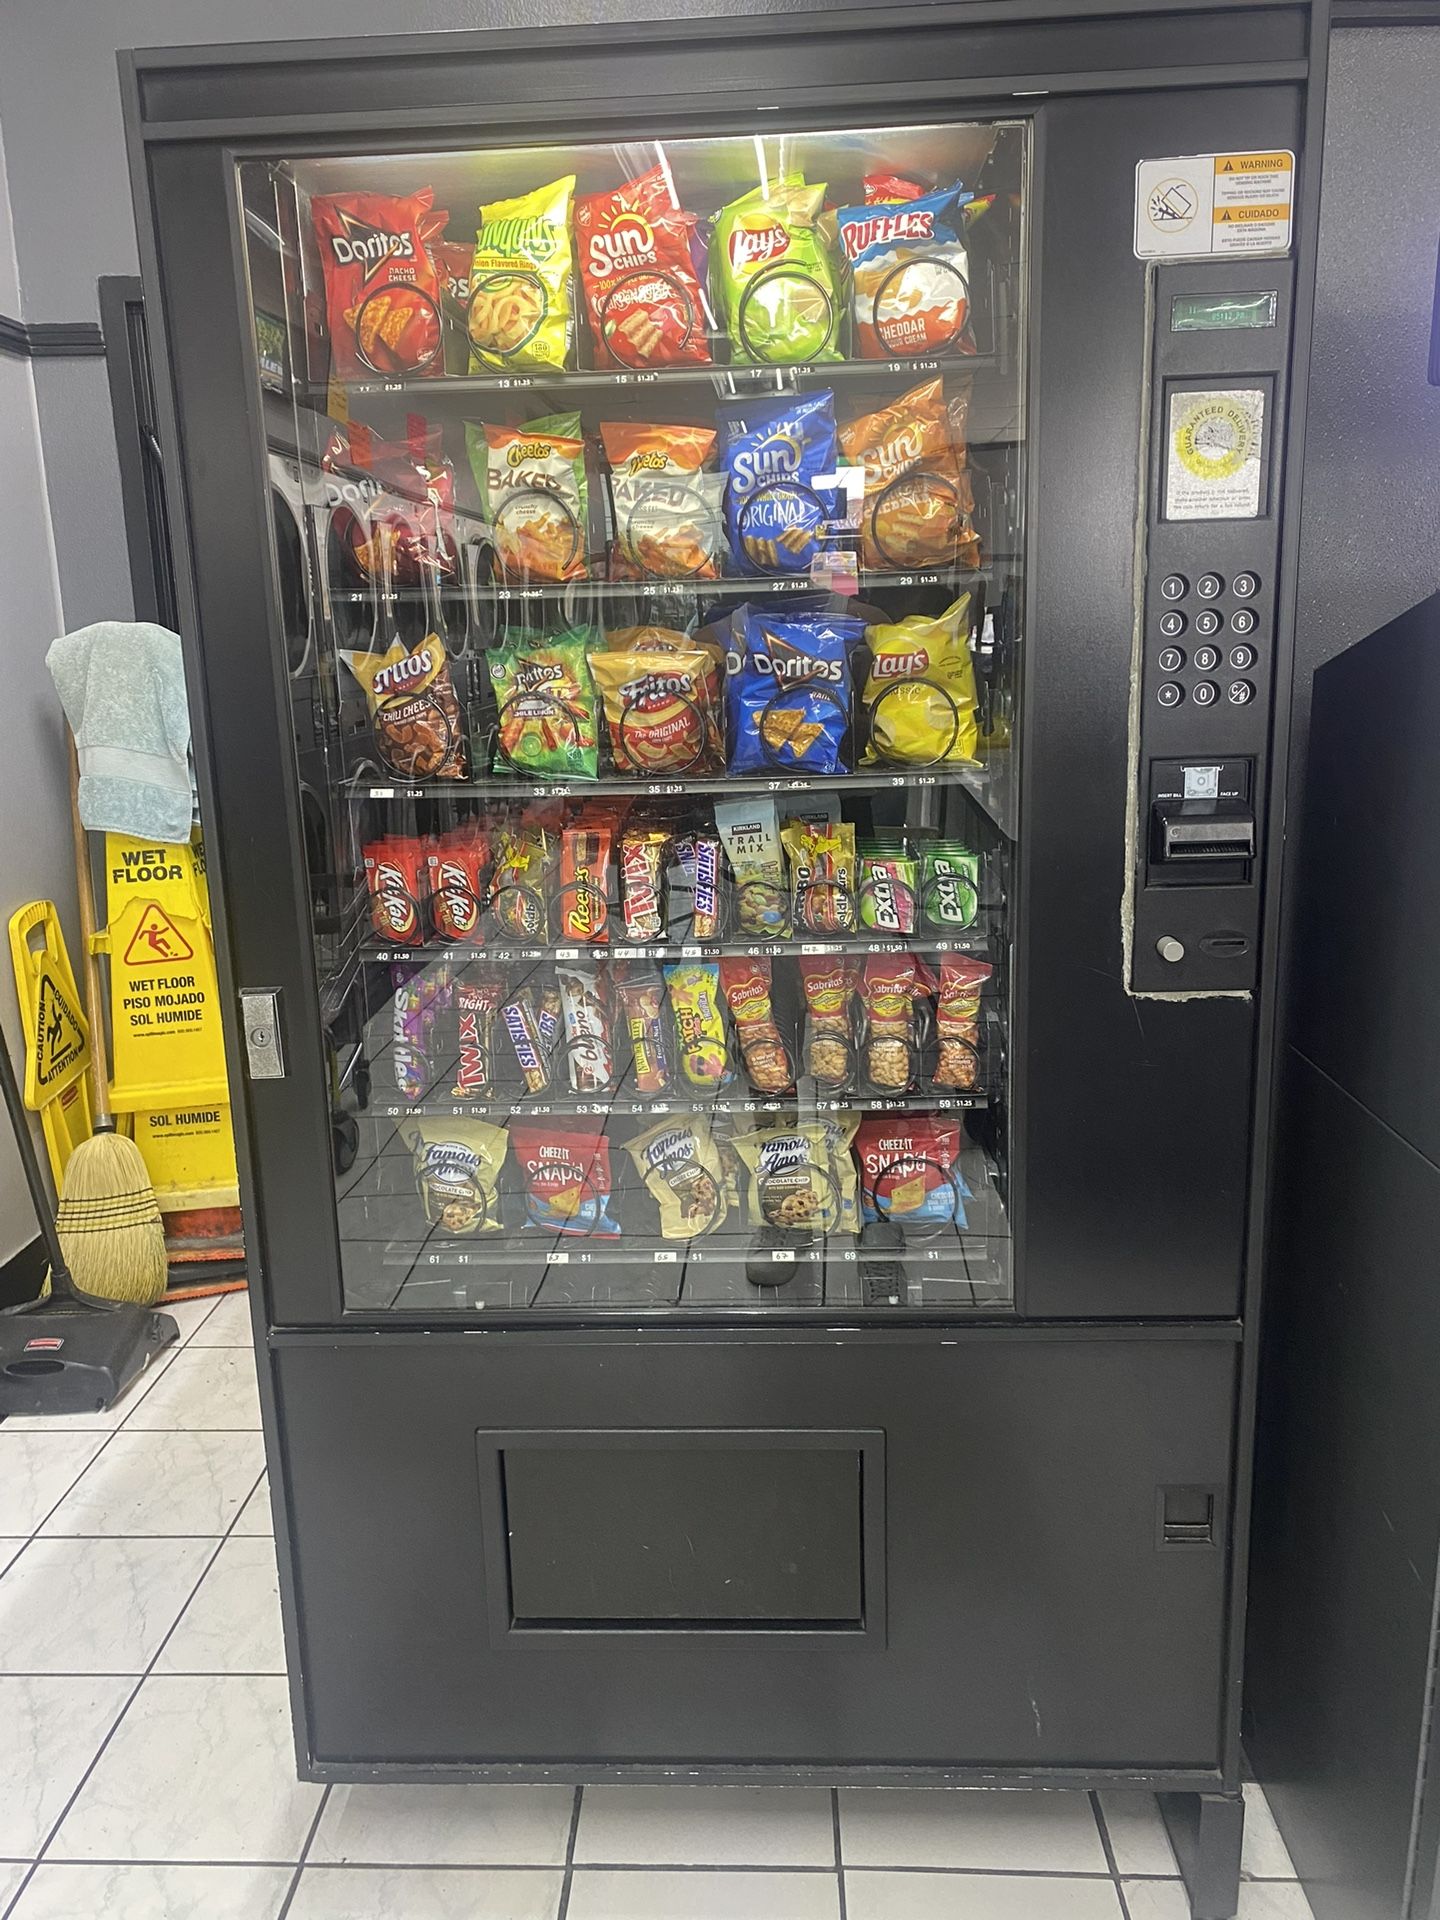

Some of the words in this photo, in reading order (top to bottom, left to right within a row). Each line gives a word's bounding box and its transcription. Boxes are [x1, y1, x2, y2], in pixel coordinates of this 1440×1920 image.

[1240, 159, 1283, 169] WARNING
[1238, 208, 1279, 219] CUIDADO
[842, 213, 934, 259] RUFFLES
[333, 232, 414, 263] Doritos
[733, 226, 788, 264] Lay's
[589, 229, 655, 278] Sun
[490, 258, 519, 268] Flavored
[613, 251, 657, 270] CHIPS
[389, 267, 415, 275] NACHO
[388, 274, 417, 282] CHEESE
[888, 363, 901, 372] 19
[919, 361, 938, 369] $1.25
[750, 369, 762, 378] 17
[498, 379, 510, 388] 13
[513, 378, 531, 387] $1.25
[615, 375, 627, 384] 15
[637, 374, 655, 383] $1.25
[1184, 406, 1225, 456] GUARANTEED
[1227, 409, 1247, 454] DELIVERY
[507, 442, 551, 468] Cheetos
[732, 450, 802, 494] Sun
[487, 468, 562, 491] BAKED
[756, 472, 800, 487] CHIPS
[900, 576, 913, 585] 29
[920, 575, 938, 583] $1.25
[643, 587, 656, 595] 25
[772, 582, 785, 591] 27
[791, 581, 808, 589] $1.25
[1169, 582, 1175, 594] 1
[1204, 581, 1212, 593] 2
[1239, 580, 1247, 592] 3
[351, 593, 363, 602] 21
[499, 591, 511, 599] 23
[1167, 618, 1175, 630] 4
[1203, 617, 1210, 629] 5
[1238, 616, 1246, 628] 6
[1166, 654, 1173, 666] 7
[1201, 653, 1209, 665] 8
[1236, 651, 1244, 664] 9
[753, 655, 843, 681] Doritos
[872, 650, 927, 679] Lay's
[619, 674, 692, 709] Fritos
[1199, 687, 1207, 700] 0
[648, 717, 691, 738] ORIGINAL
[768, 781, 780, 790] 37
[892, 777, 904, 785] 39
[918, 776, 936, 784] $1.25
[534, 787, 545, 796] 33
[648, 785, 661, 794] 35
[732, 824, 762, 832] KIRKLAND
[728, 833, 772, 845] TRAIL
[736, 845, 764, 854] MIX
[121, 849, 167, 867] WET
[113, 865, 184, 884] FLOOR
[694, 841, 718, 916] SATISFIES
[622, 844, 659, 927] TWIX
[747, 946, 760, 955] 46
[868, 944, 880, 952] 48
[935, 942, 948, 950] 49
[954, 942, 971, 950] $1.50
[376, 952, 388, 961] 40
[393, 952, 410, 960] $1.50
[443, 952, 454, 960] 41
[498, 952, 510, 960] 42
[129, 979, 156, 993] WET
[157, 976, 195, 990] FLOOR
[806, 975, 843, 994] Sabritas
[731, 983, 764, 1005] Sabritas
[123, 996, 151, 1010] PISO
[155, 992, 205, 1007] MOJADO
[53, 988, 79, 1032] CUIDADO
[130, 1014, 153, 1026] SOL
[156, 1009, 203, 1024] HUMIDE
[37, 999, 46, 1062] CAUTION
[457, 1012, 486, 1086] TWIX
[47, 1047, 79, 1084] ATTENTION
[631, 1104, 643, 1113] 54
[692, 1104, 703, 1112] 55
[744, 1103, 756, 1111] 56
[816, 1101, 828, 1110] 57
[871, 1100, 882, 1109] 58
[939, 1099, 950, 1108] 59
[956, 1099, 973, 1107] $1.25
[387, 1107, 399, 1115] 50
[452, 1106, 463, 1115] 51
[471, 1106, 487, 1114] $1.50
[510, 1106, 521, 1114] 52
[576, 1105, 587, 1113] 53
[149, 1114, 172, 1127] SOL
[175, 1110, 221, 1125] HUMIDE
[425, 1144, 482, 1167] Famous
[429, 1255, 440, 1264] 61
[458, 1255, 468, 1264] $1
[581, 1253, 591, 1262] $1
[692, 1252, 702, 1261] $1
[809, 1252, 820, 1260] $1
[844, 1252, 856, 1261] 69
[927, 1251, 938, 1260] $1
